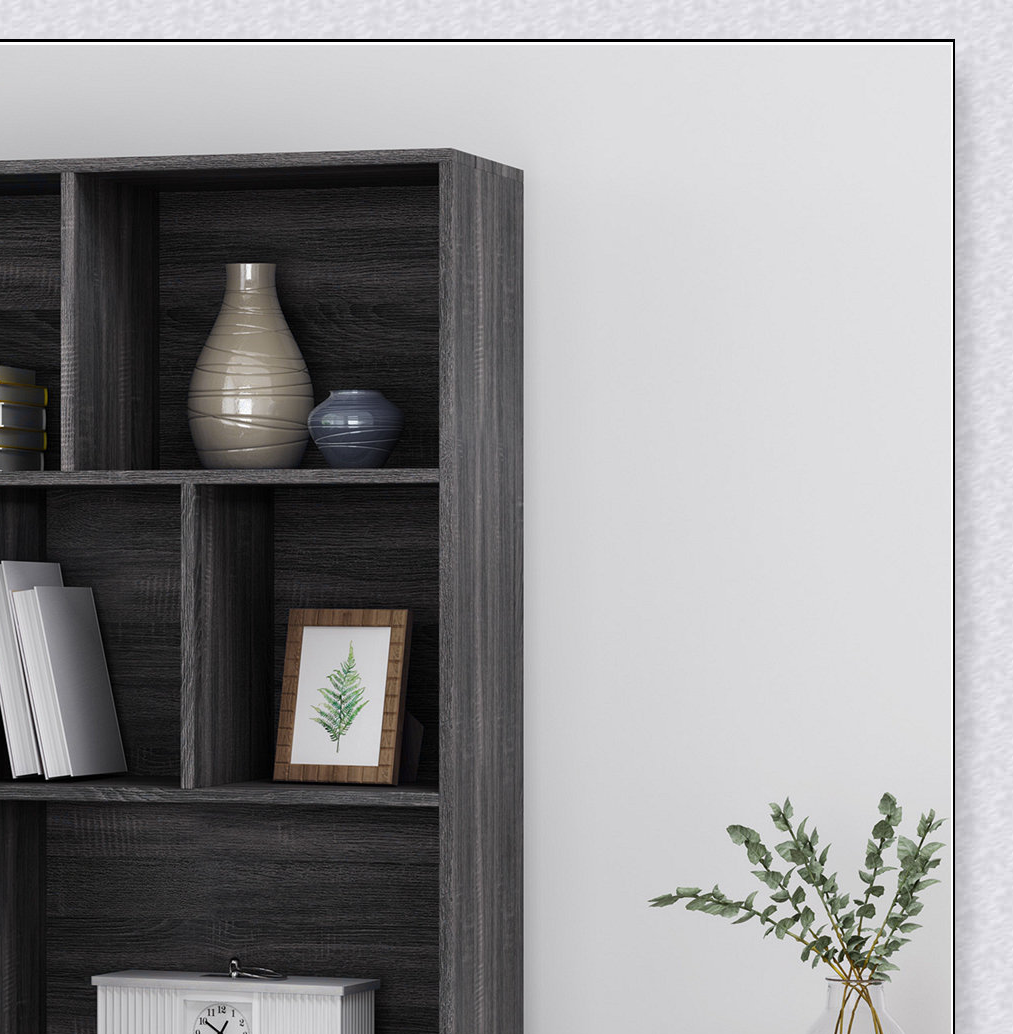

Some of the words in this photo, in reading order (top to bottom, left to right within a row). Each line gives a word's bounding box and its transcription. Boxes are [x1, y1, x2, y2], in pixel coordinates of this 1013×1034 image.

[207, 1008, 215, 1016] 11
[217, 1005, 227, 1014] 12
[199, 1017, 208, 1025] 10
[239, 1018, 245, 1027] 2
